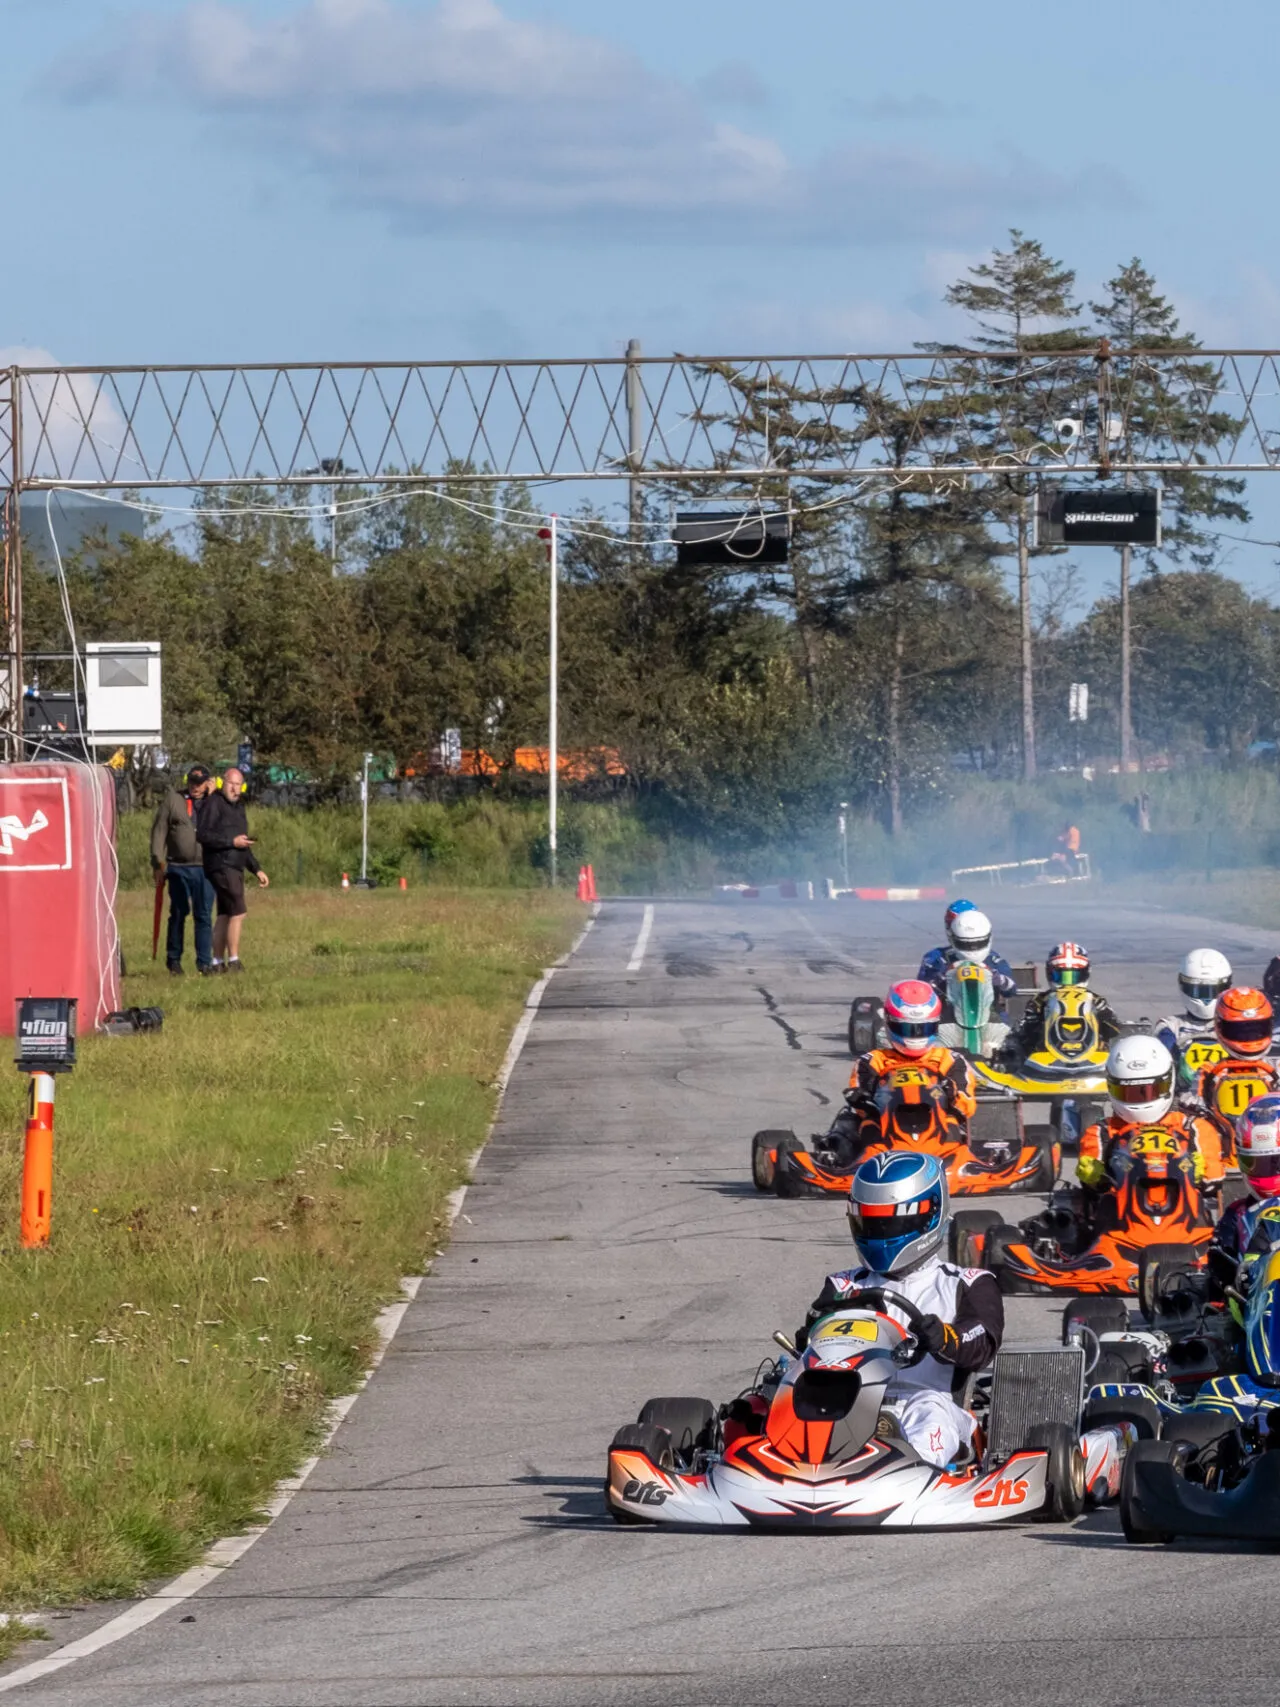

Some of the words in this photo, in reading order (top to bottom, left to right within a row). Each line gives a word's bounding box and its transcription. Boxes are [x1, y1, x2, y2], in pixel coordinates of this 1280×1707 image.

[961, 969, 980, 979] 61
[1061, 991, 1083, 999] 77
[896, 1072, 924, 1084] 31
[1230, 1083, 1254, 1108] 11
[1131, 1135, 1180, 1152] 314
[833, 1321, 855, 1335] 4
